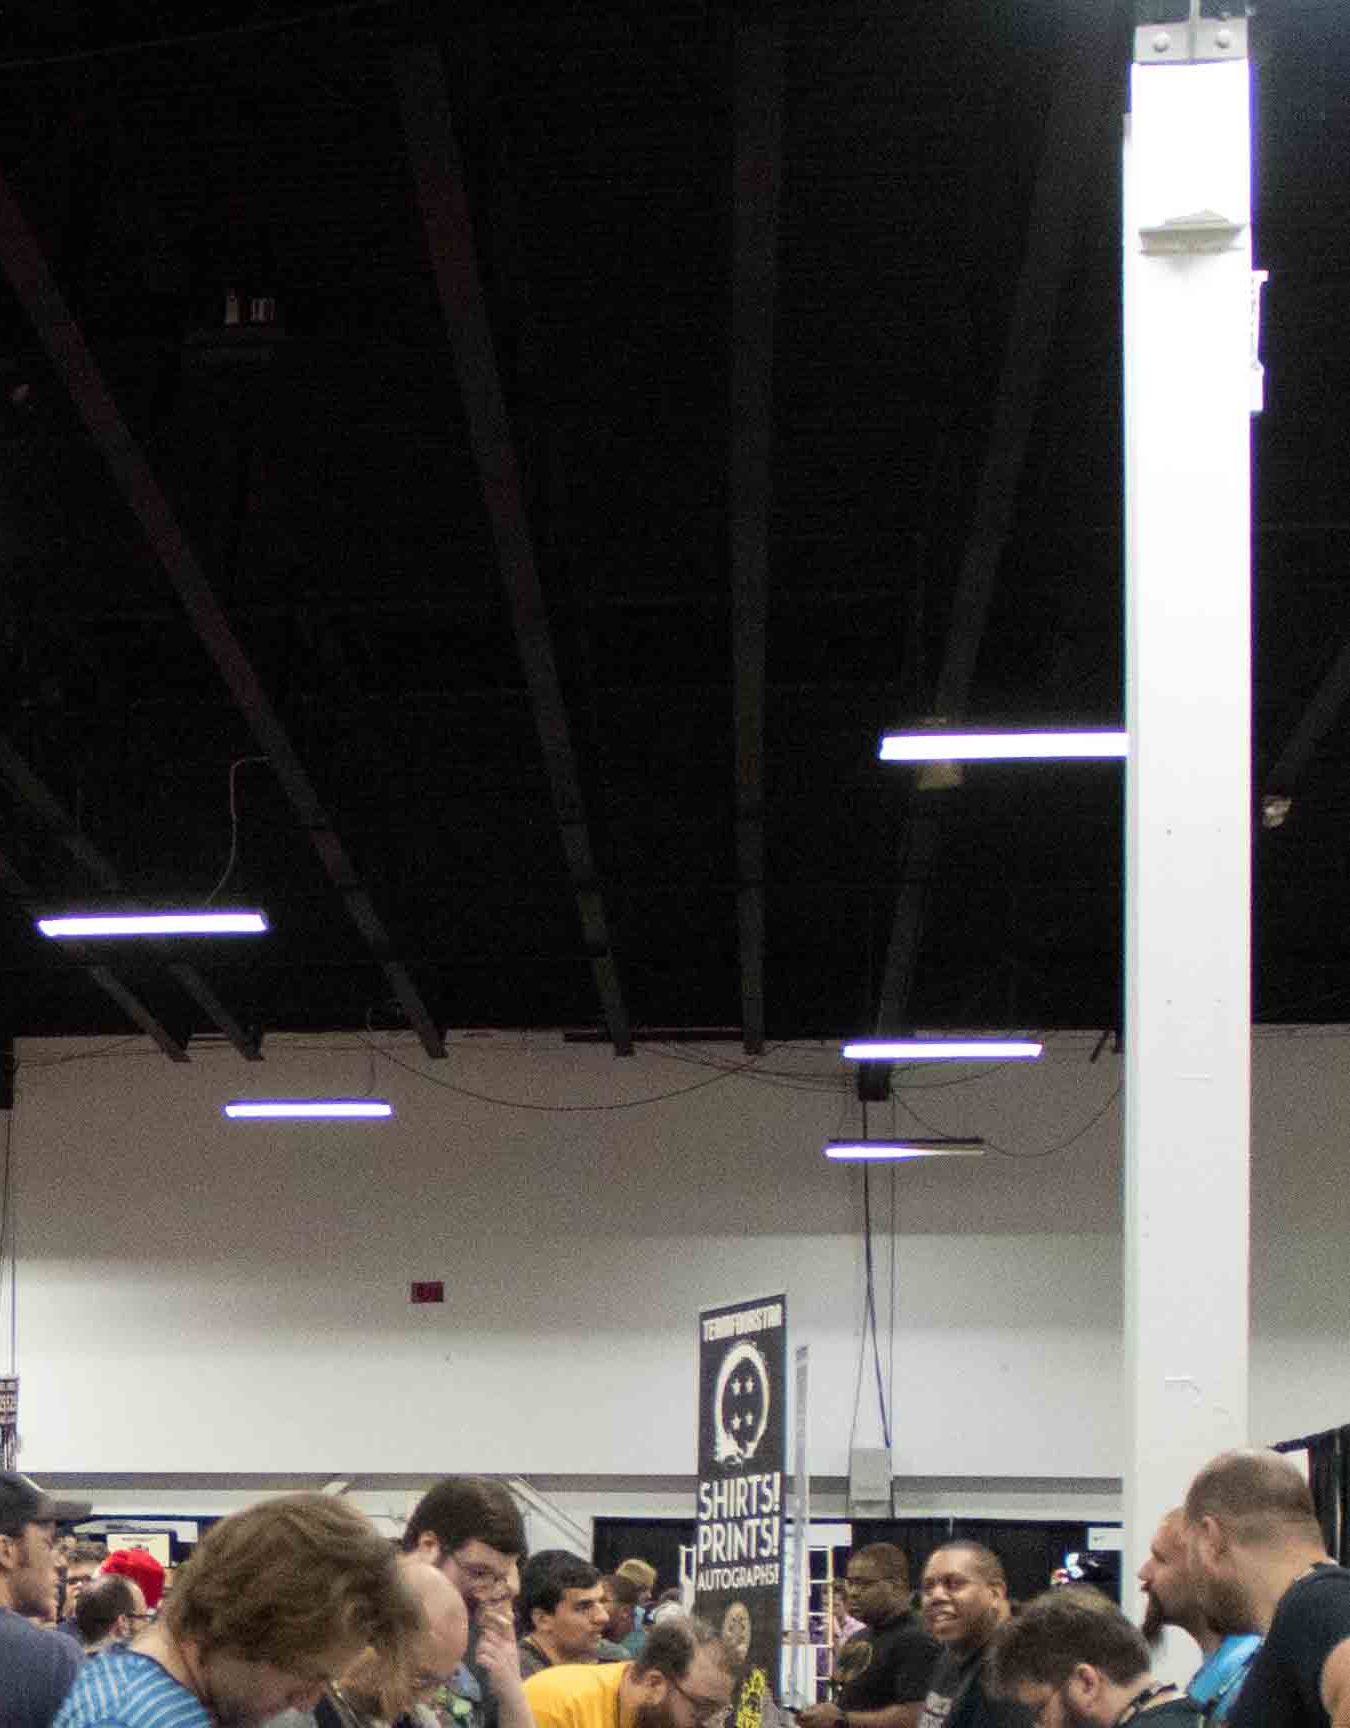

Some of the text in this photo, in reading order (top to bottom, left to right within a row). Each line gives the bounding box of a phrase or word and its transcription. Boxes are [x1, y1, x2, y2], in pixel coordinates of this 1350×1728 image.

[699, 1471, 781, 1522] SHIRTS!
[698, 1516, 781, 1565] PRINTS!
[696, 1565, 780, 1591] AUTOGRAPHS!
